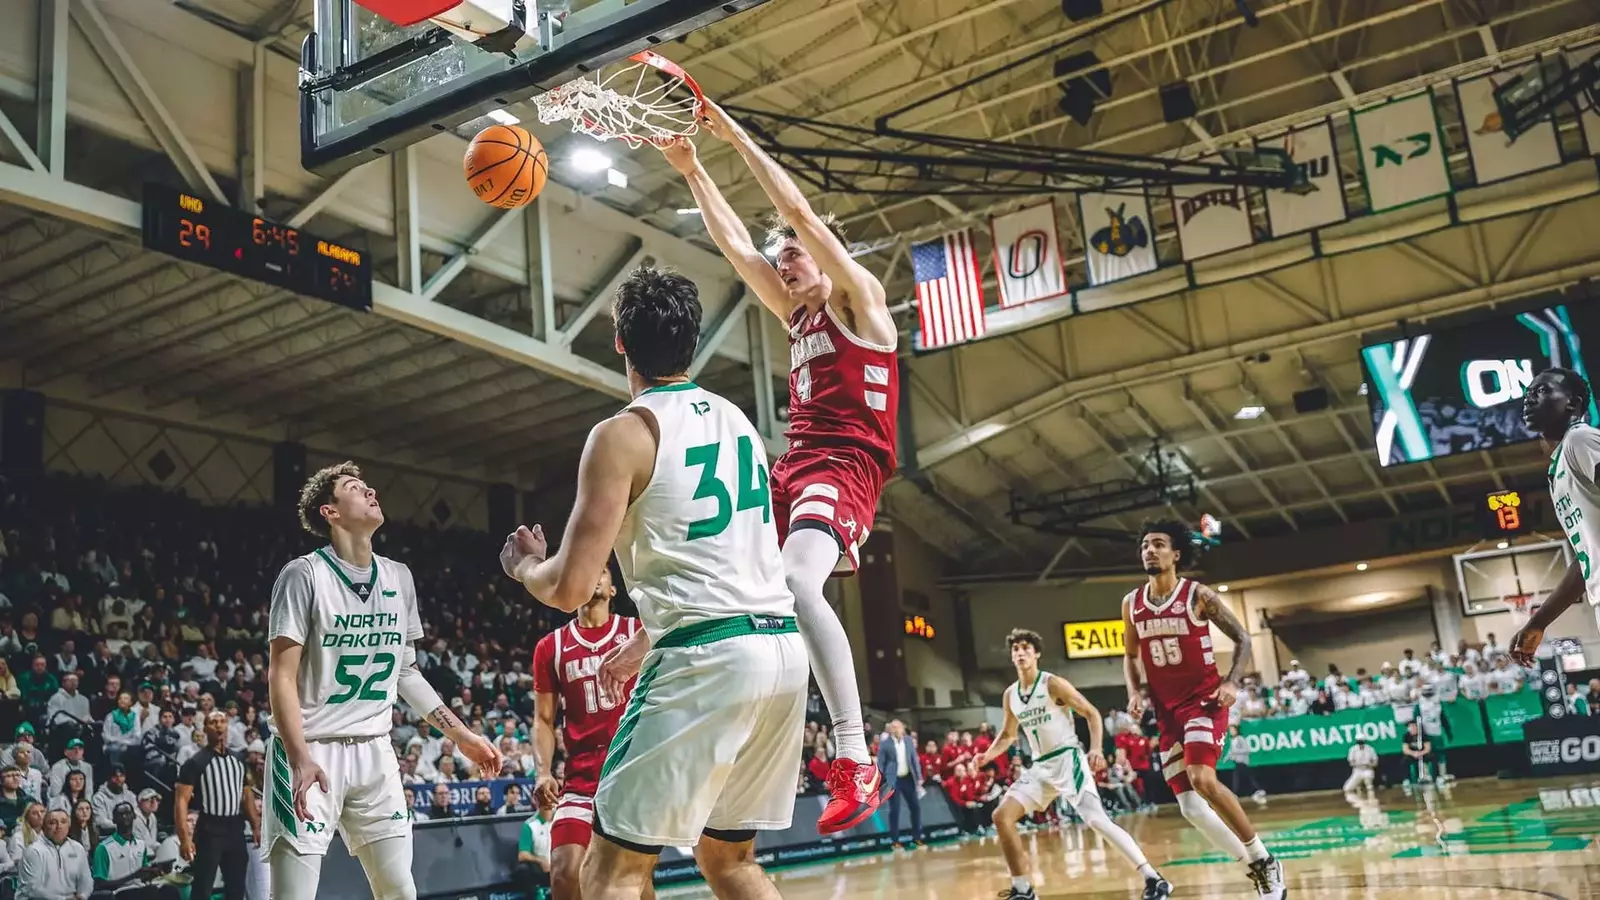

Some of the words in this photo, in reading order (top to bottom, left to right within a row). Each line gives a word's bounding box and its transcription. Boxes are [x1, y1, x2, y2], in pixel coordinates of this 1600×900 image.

[179, 219, 211, 249] 29
[252, 217, 300, 255] 6:45
[316, 240, 361, 267] ALABAMA
[684, 435, 770, 541] 34
[1497, 506, 1520, 529] 13
[334, 613, 398, 631] NORTH
[322, 632, 402, 648] DAKOTA
[1149, 637, 1183, 668] 95
[325, 652, 395, 704] 52
[1248, 729, 1307, 753] ODAK
[1309, 719, 1397, 748] NATION
